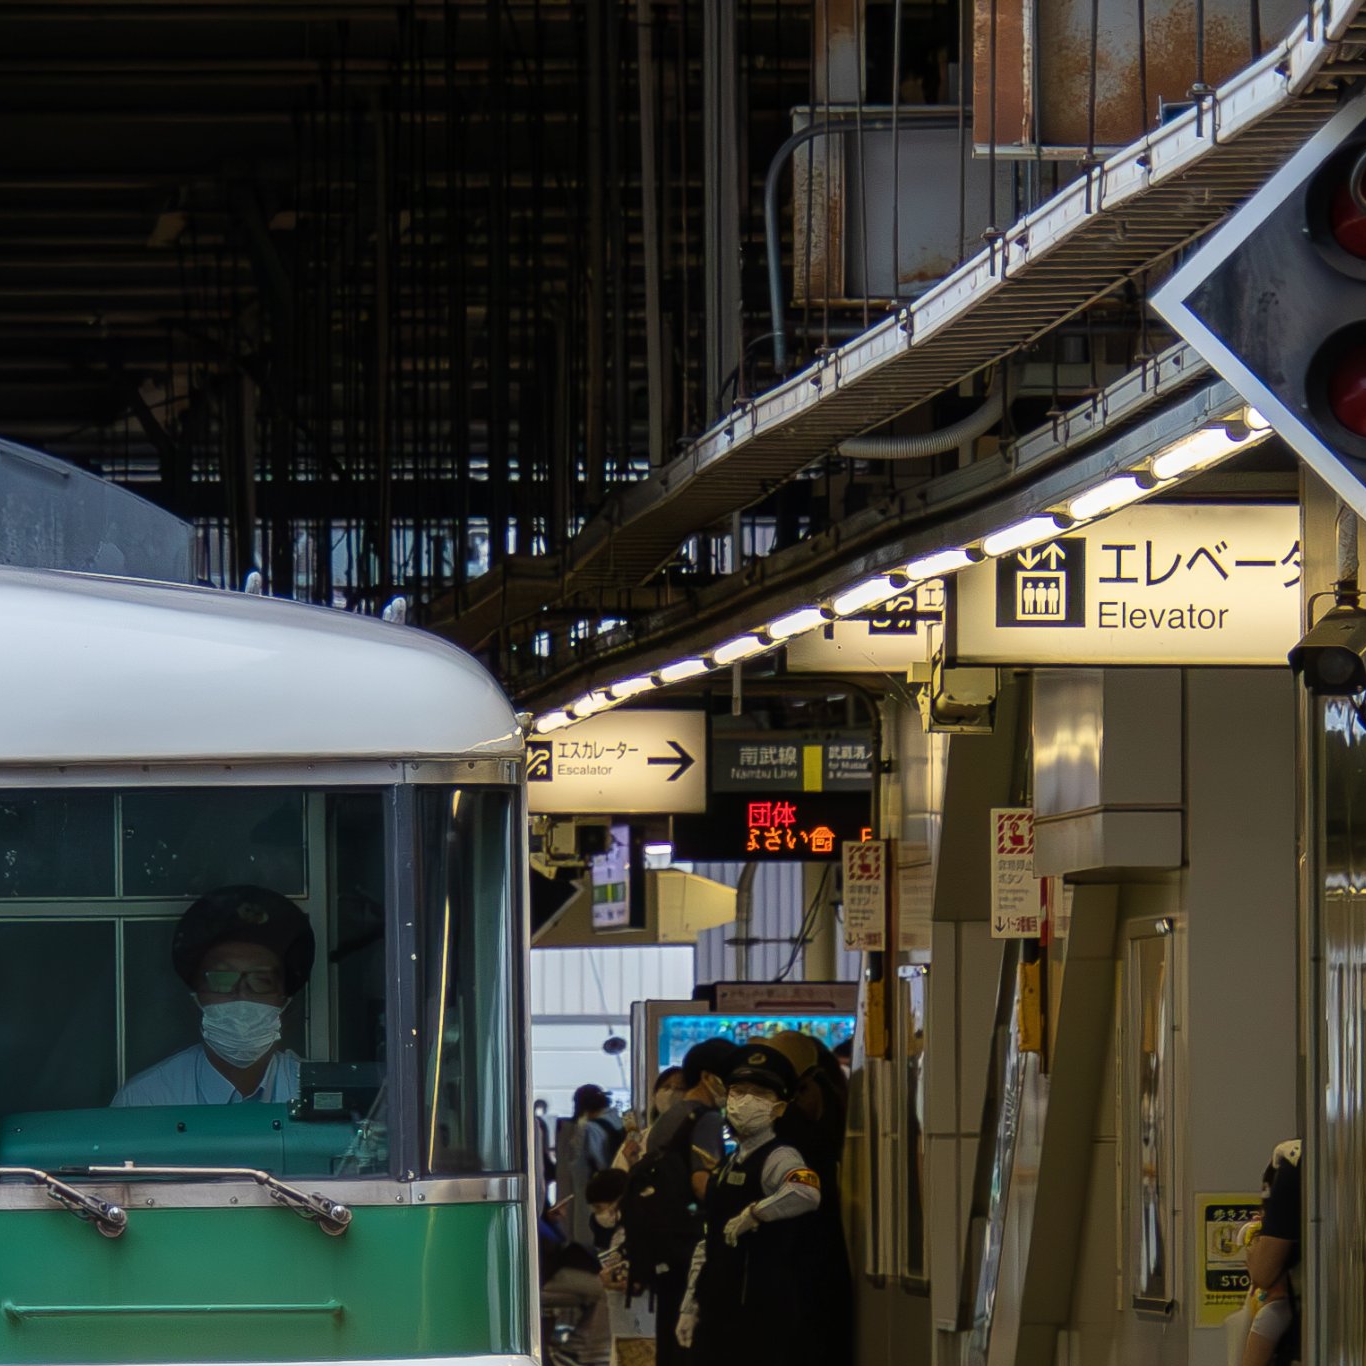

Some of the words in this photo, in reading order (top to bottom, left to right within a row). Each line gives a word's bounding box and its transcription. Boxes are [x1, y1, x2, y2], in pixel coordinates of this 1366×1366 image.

[1099, 601, 1230, 630] Elevator
[557, 741, 639, 760] エスカレーター
[739, 745, 797, 766] 南武線
[557, 764, 613, 776] Escalator
[730, 767, 771, 779] Nambu
[773, 767, 797, 779] Line
[748, 802, 797, 828] 団体
